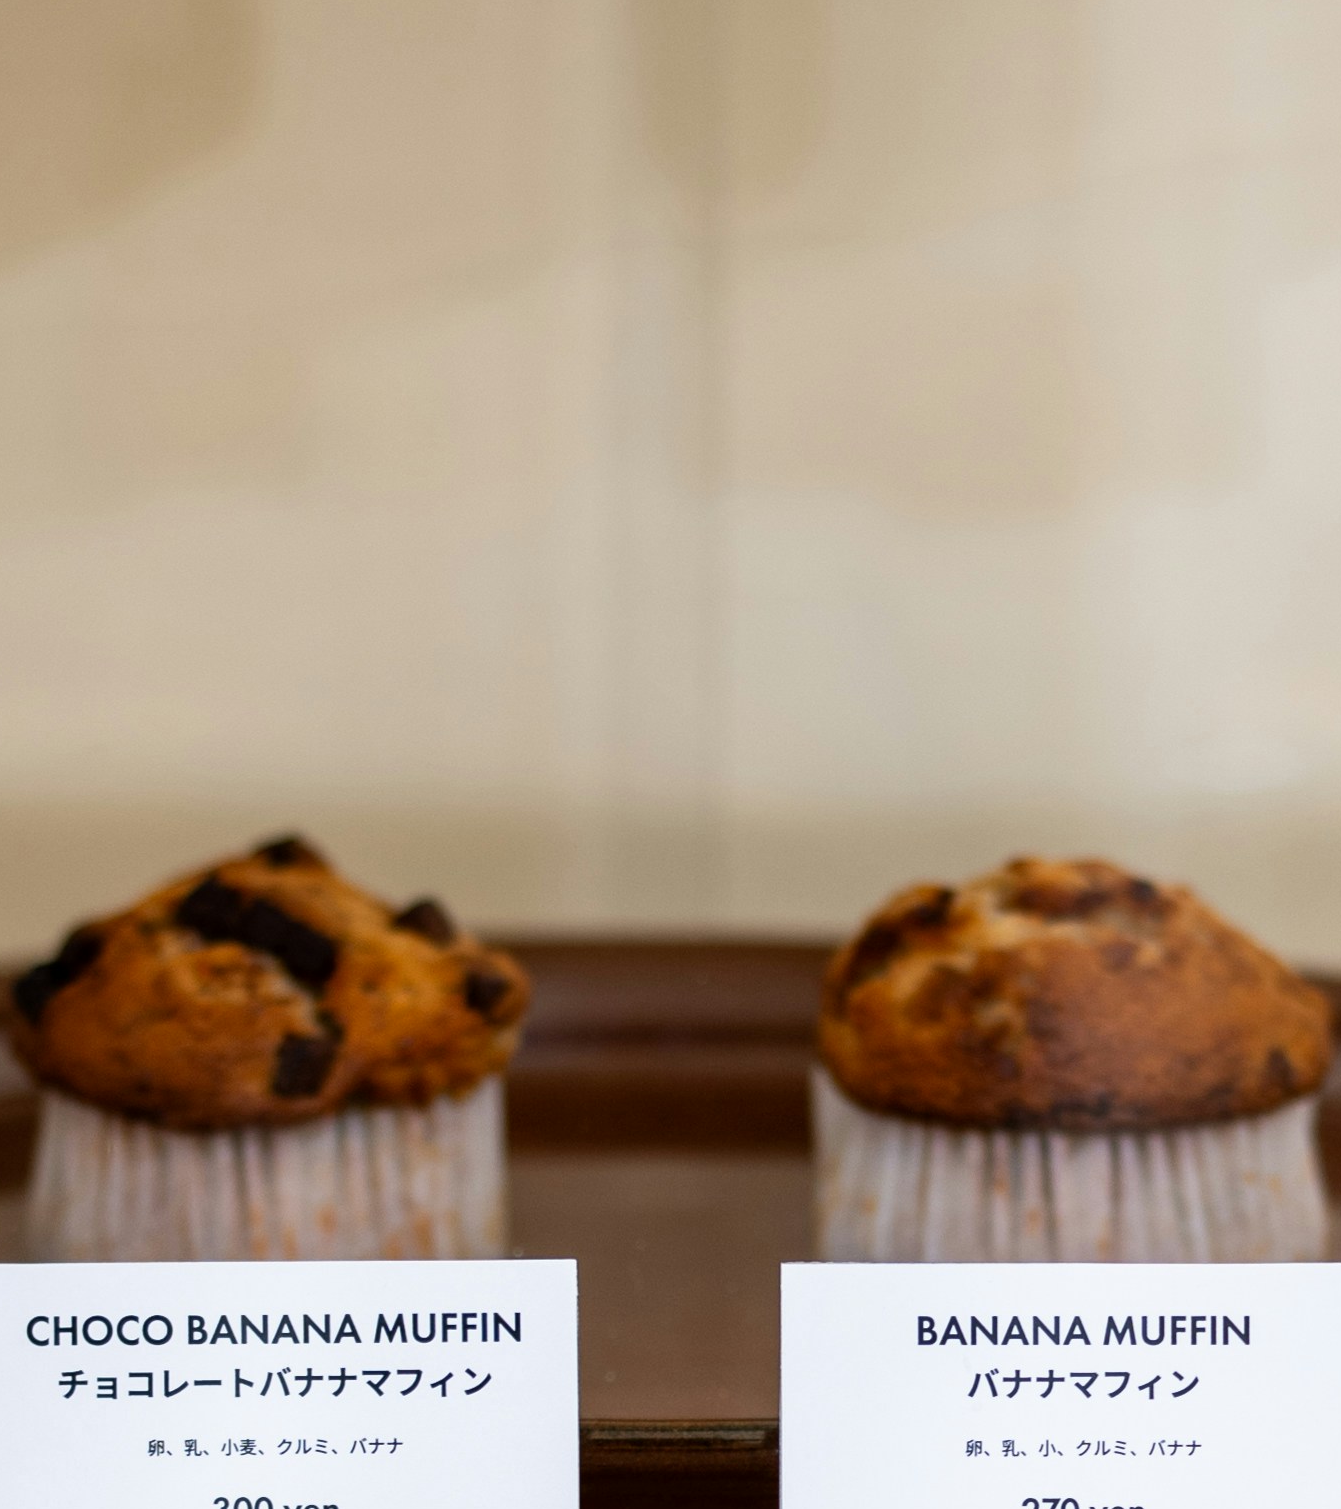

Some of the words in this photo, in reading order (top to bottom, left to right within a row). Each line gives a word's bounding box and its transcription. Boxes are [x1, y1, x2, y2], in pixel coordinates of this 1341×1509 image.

[26, 1314, 174, 1347] CHOCO
[187, 1313, 362, 1345] BANANA
[373, 1312, 522, 1344] MUFFIN
[917, 1315, 1092, 1346] BANANA
[1102, 1315, 1251, 1346] MUFFIN
[58, 1366, 492, 1400] チョコレートバナナマフィン
[967, 1367, 1200, 1400] バナナマフィン
